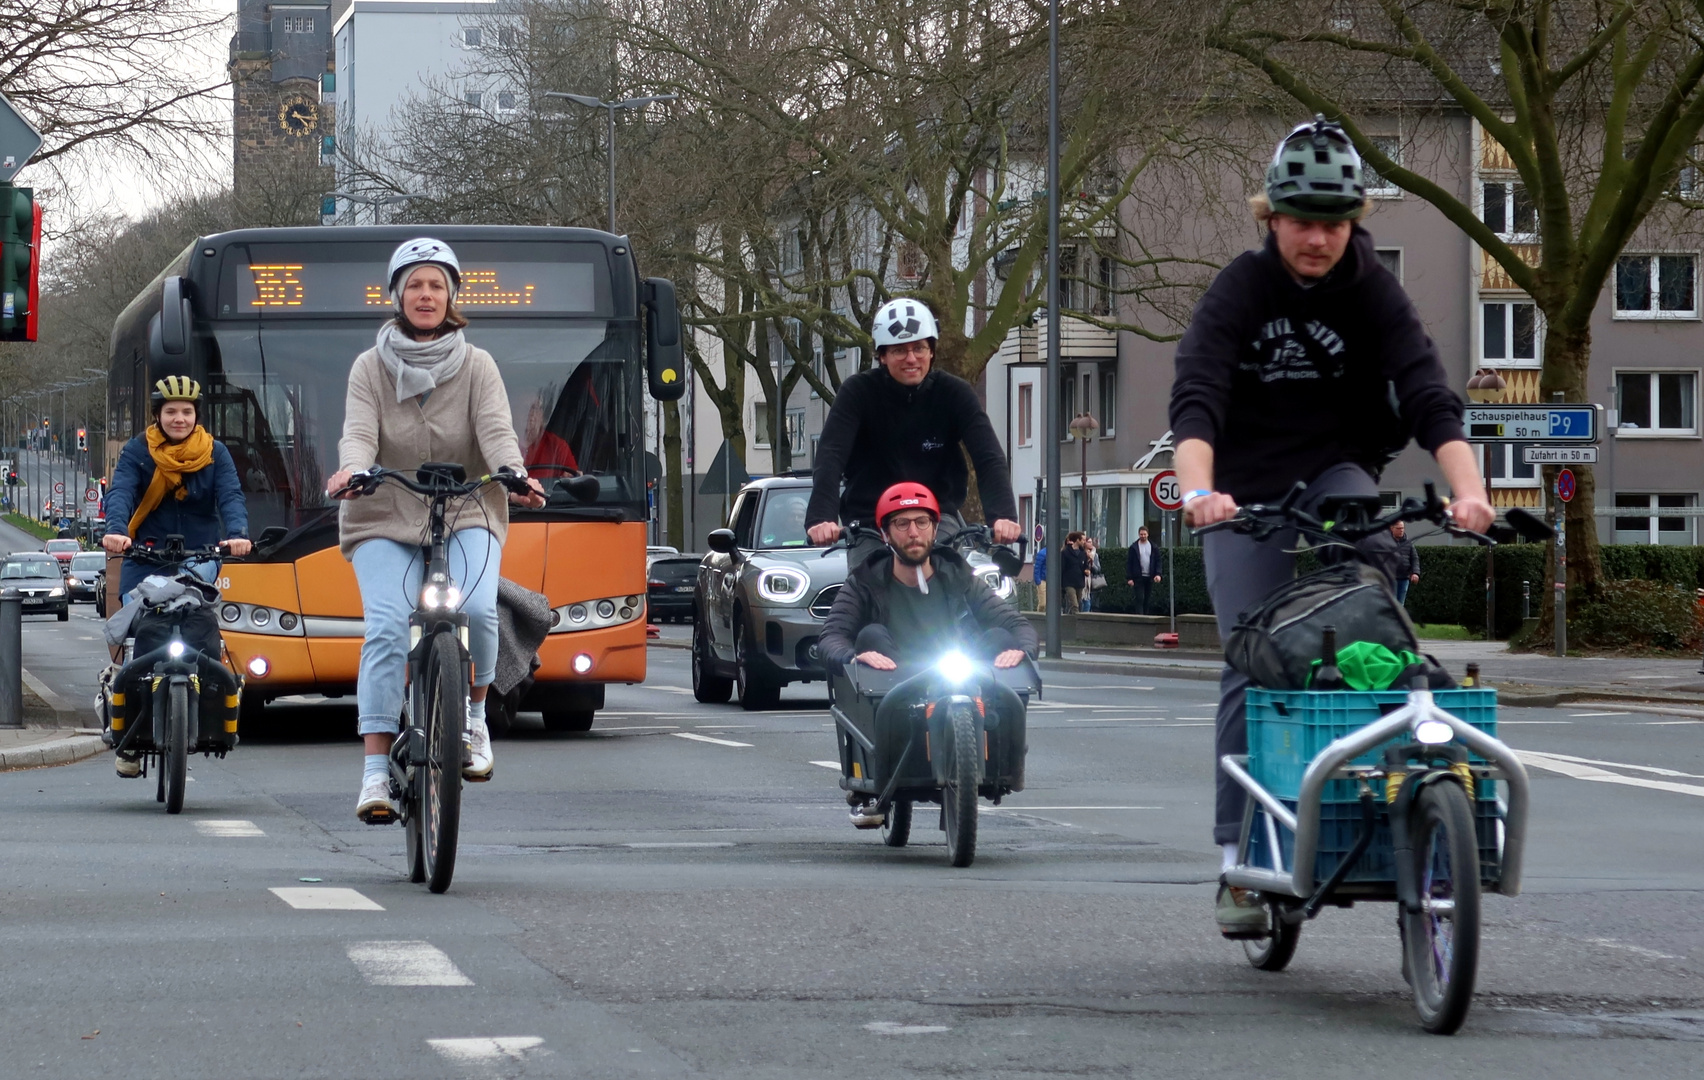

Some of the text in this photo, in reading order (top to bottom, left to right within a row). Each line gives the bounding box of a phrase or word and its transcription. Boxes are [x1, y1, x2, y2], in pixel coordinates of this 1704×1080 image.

[1470, 411, 1547, 423] Schauspielhaus
[1515, 427, 1541, 437] 50 m
[1530, 450, 1591, 460] Zufahrt in 50 m
[1159, 482, 1180, 500] 50
